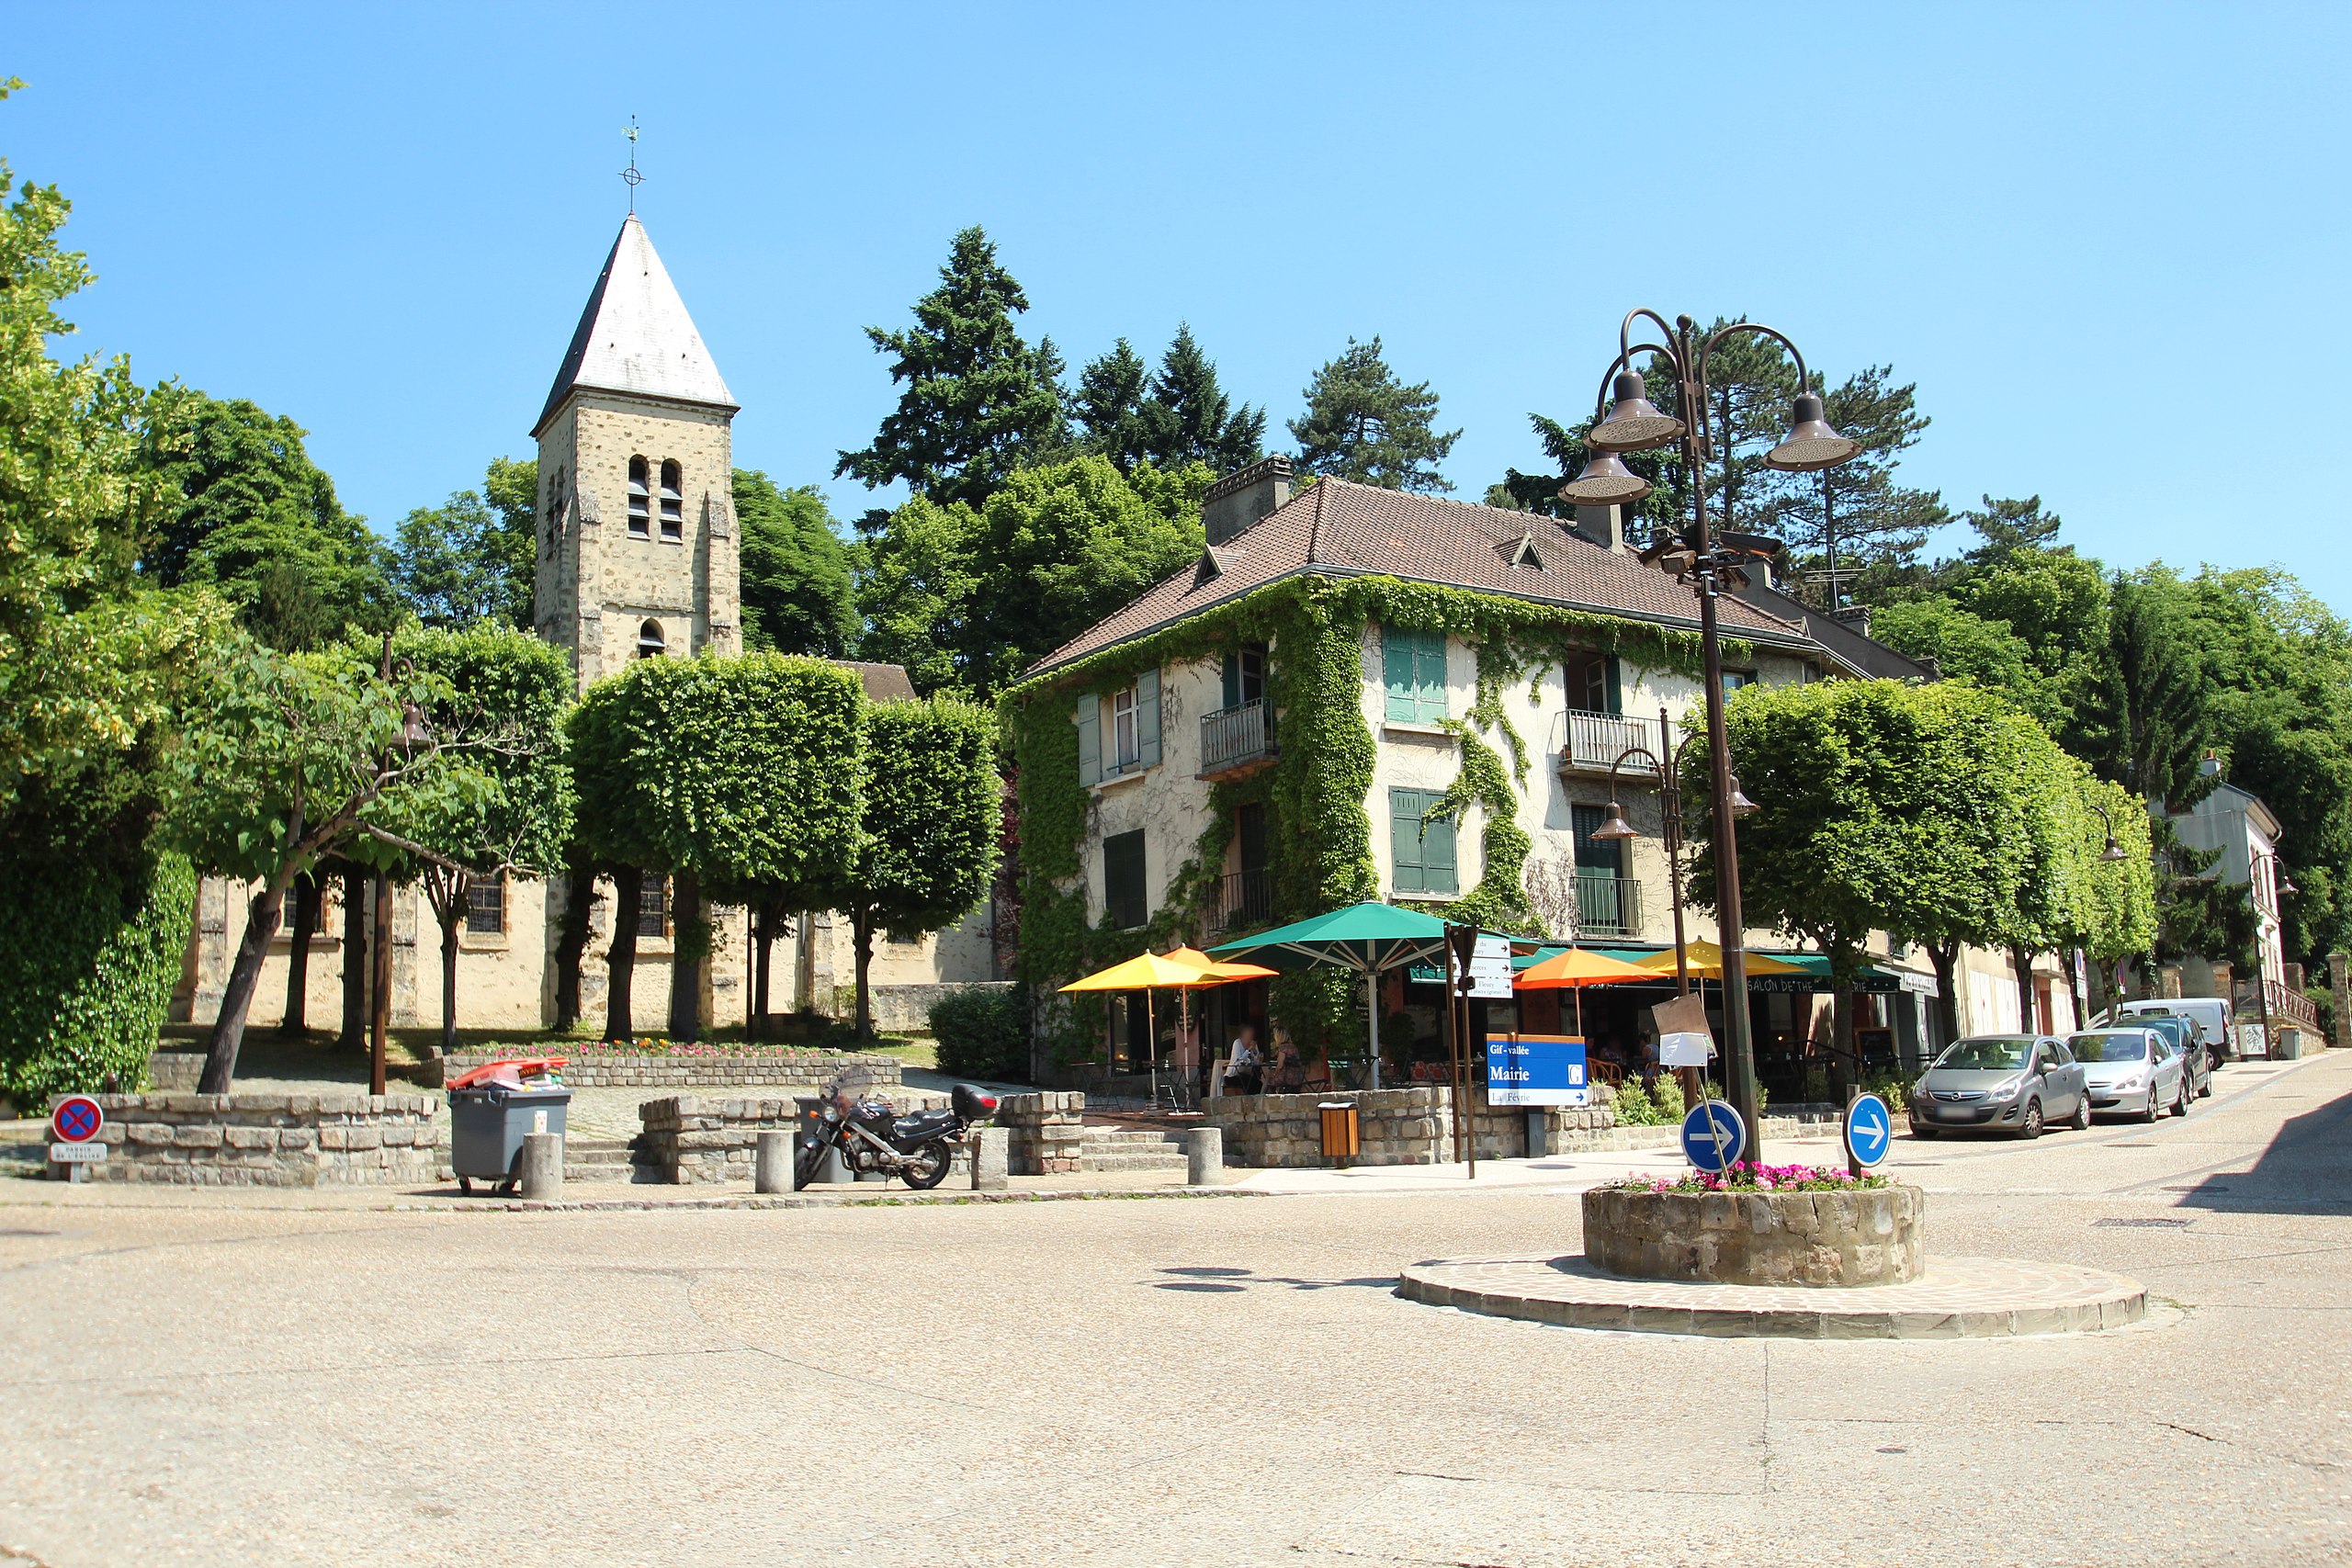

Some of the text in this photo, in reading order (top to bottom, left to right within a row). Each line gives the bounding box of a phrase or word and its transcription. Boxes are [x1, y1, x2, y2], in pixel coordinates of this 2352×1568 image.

[1478, 981, 1494, 989] Fleury
[1747, 979, 1778, 992] SALON
[1781, 981, 1793, 992] DE
[1489, 1066, 1530, 1081] Mairie
[1508, 1092, 1531, 1102] Févrie
